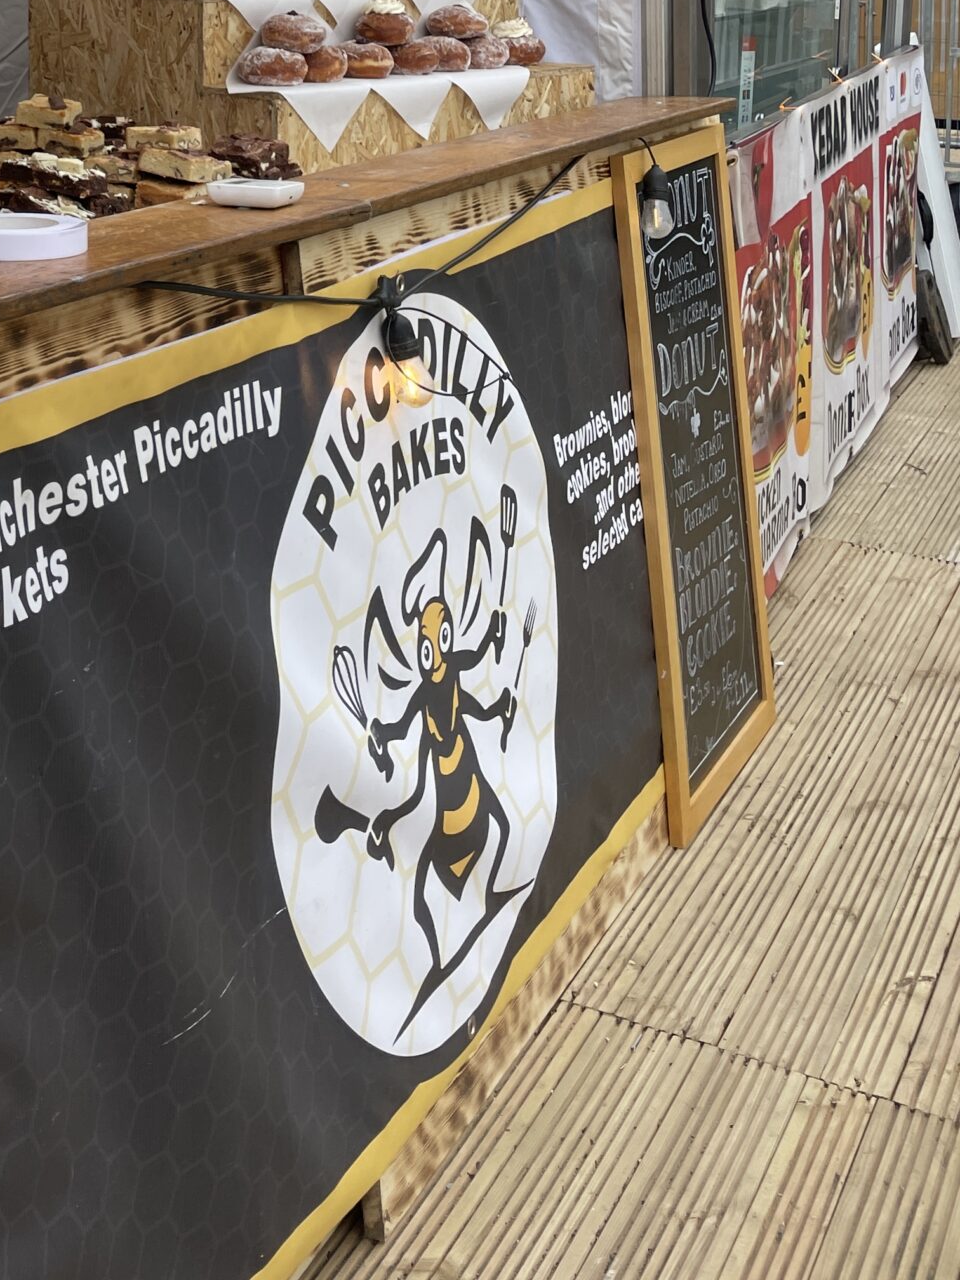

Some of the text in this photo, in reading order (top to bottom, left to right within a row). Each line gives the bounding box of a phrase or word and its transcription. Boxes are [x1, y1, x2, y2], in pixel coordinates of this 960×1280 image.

[810, 75, 880, 176] KEBAB HOUSE
[657, 322, 719, 398] DONUT
[133, 380, 283, 484] Piccadilly
[302, 318, 515, 552] PICCDILLY
[553, 410, 613, 468] Brownies,
[826, 365, 870, 464] DONER BOX
[368, 417, 466, 531] BAKES
[566, 450, 612, 505] cookies,
[708, 458, 727, 485] OREO
[582, 503, 630, 571] selected
[683, 495, 719, 535] PISTACHIO
